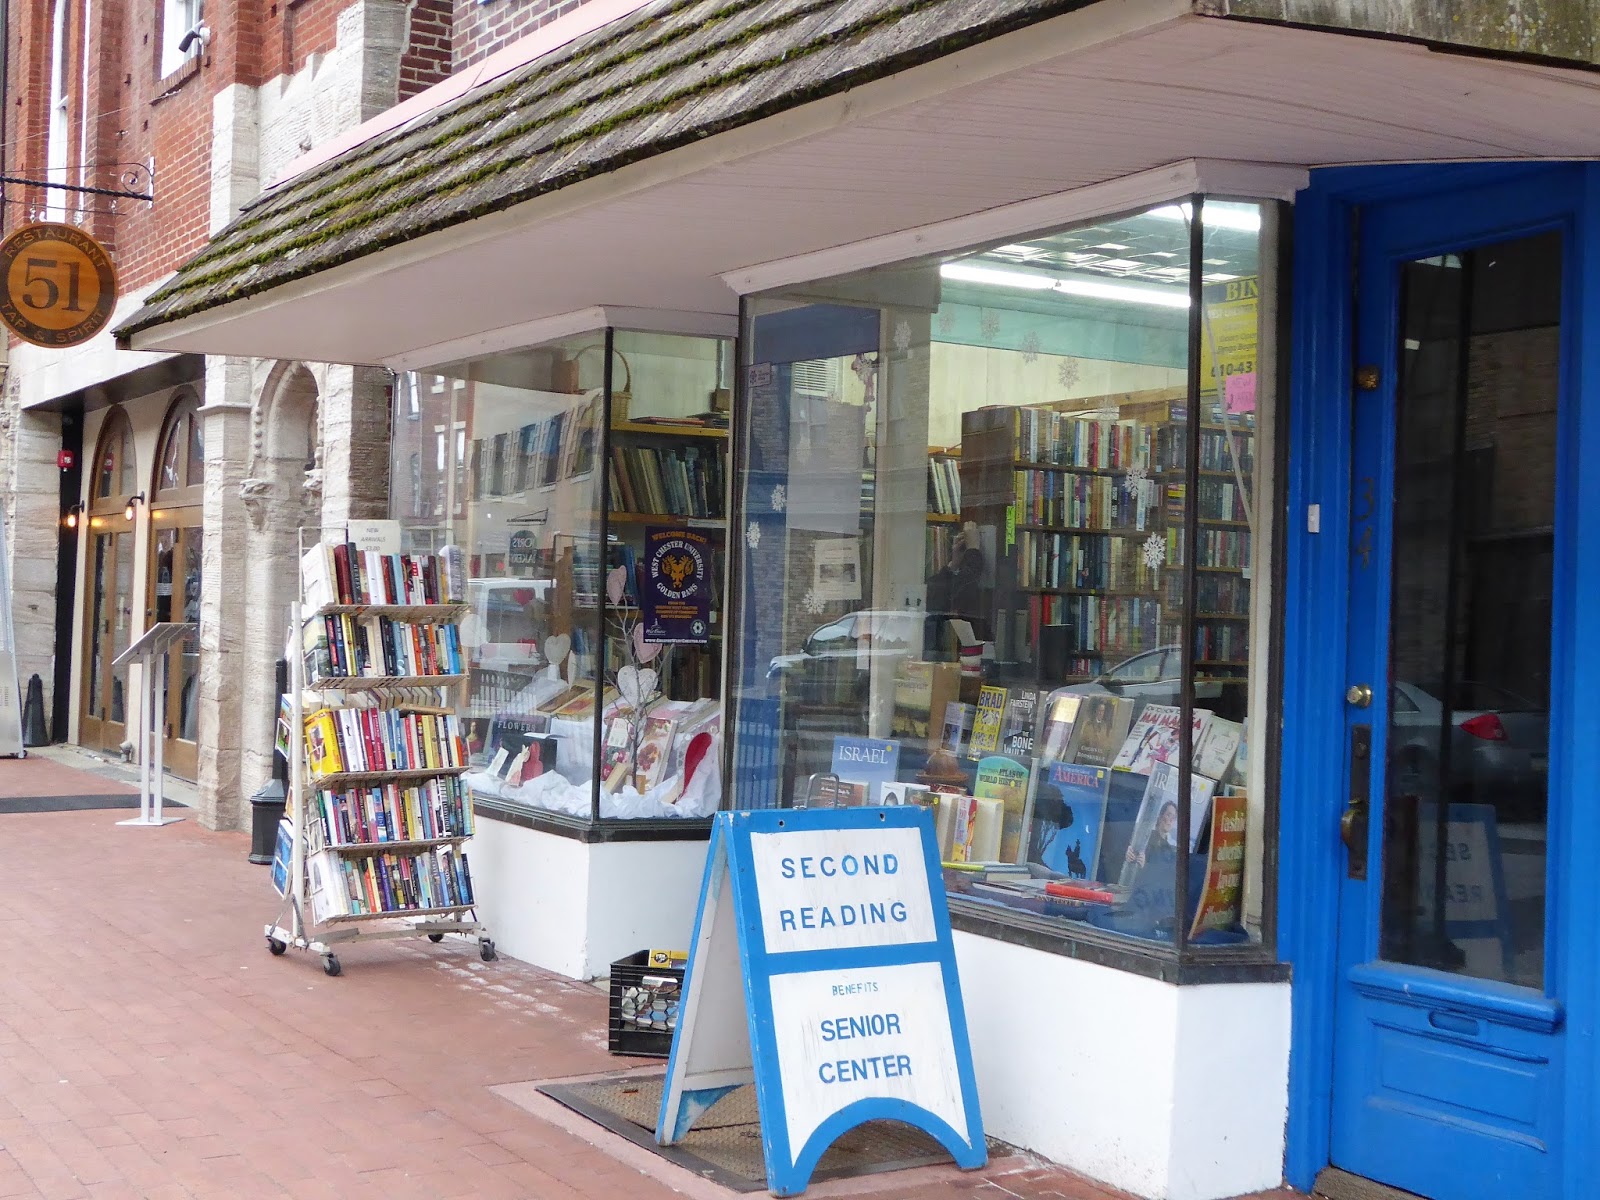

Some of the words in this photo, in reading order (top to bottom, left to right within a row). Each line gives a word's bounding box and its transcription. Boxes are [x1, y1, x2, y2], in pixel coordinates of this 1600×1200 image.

[5, 228, 107, 268] RESTAURANT
[22, 257, 86, 312] 51
[1, 301, 27, 328] TAP
[33, 330, 46, 342] &
[655, 540, 684, 558] CHESTER
[651, 557, 660, 578] WEST
[684, 541, 704, 581] UNIVERSITY
[656, 582, 681, 599] GOLDEN
[681, 583, 699, 599] RAMS
[979, 690, 1003, 709] BRAD
[497, 720, 536, 732] FLOWERS
[1012, 736, 1034, 750] BONE
[839, 745, 889, 765] ISRAEL
[1053, 765, 1099, 788] AMERICA
[781, 853, 899, 879] SECOND
[780, 902, 908, 932] READING
[832, 981, 879, 997] BENEFITS
[820, 1012, 901, 1042] SENIOR
[818, 1054, 913, 1085] CENTER
